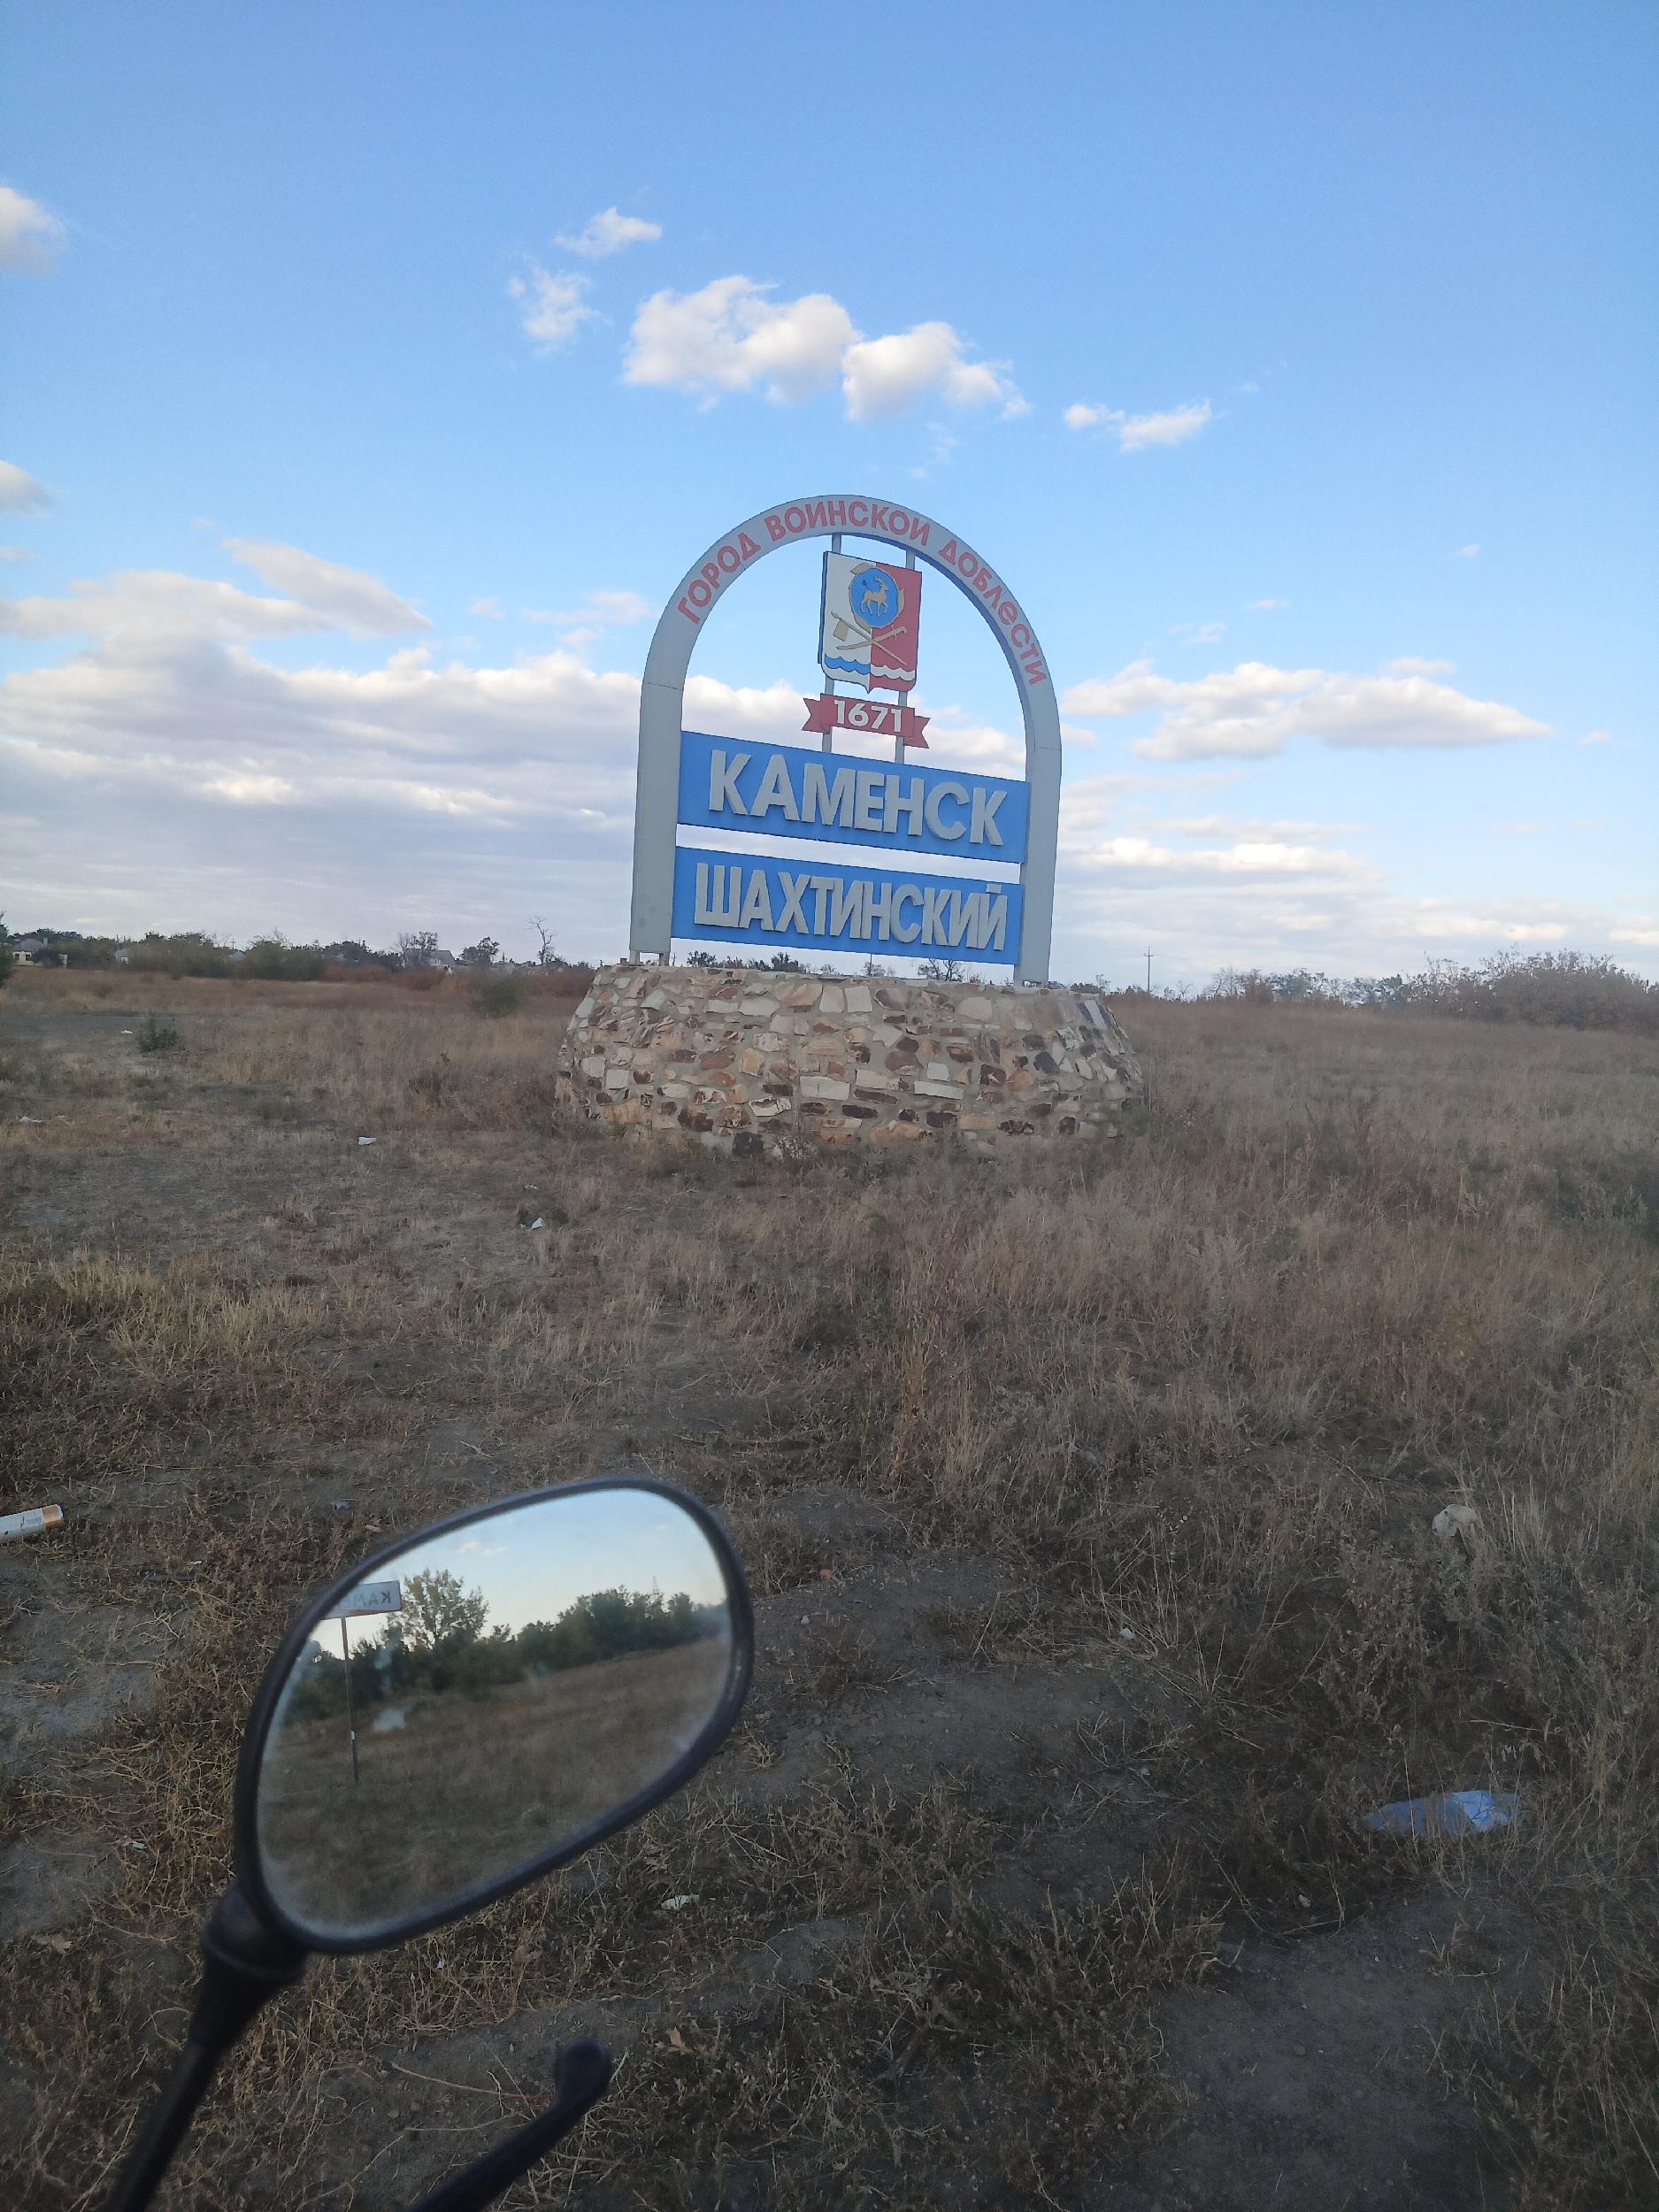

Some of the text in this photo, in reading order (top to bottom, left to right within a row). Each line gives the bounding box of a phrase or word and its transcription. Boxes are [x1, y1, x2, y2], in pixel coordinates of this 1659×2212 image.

[677, 532, 761, 625] ГОРОД
[833, 699, 902, 733] 1671
[708, 749, 1008, 847] КАМЕНСК
[694, 862, 1009, 952] ШАХТИНСКИЙ
